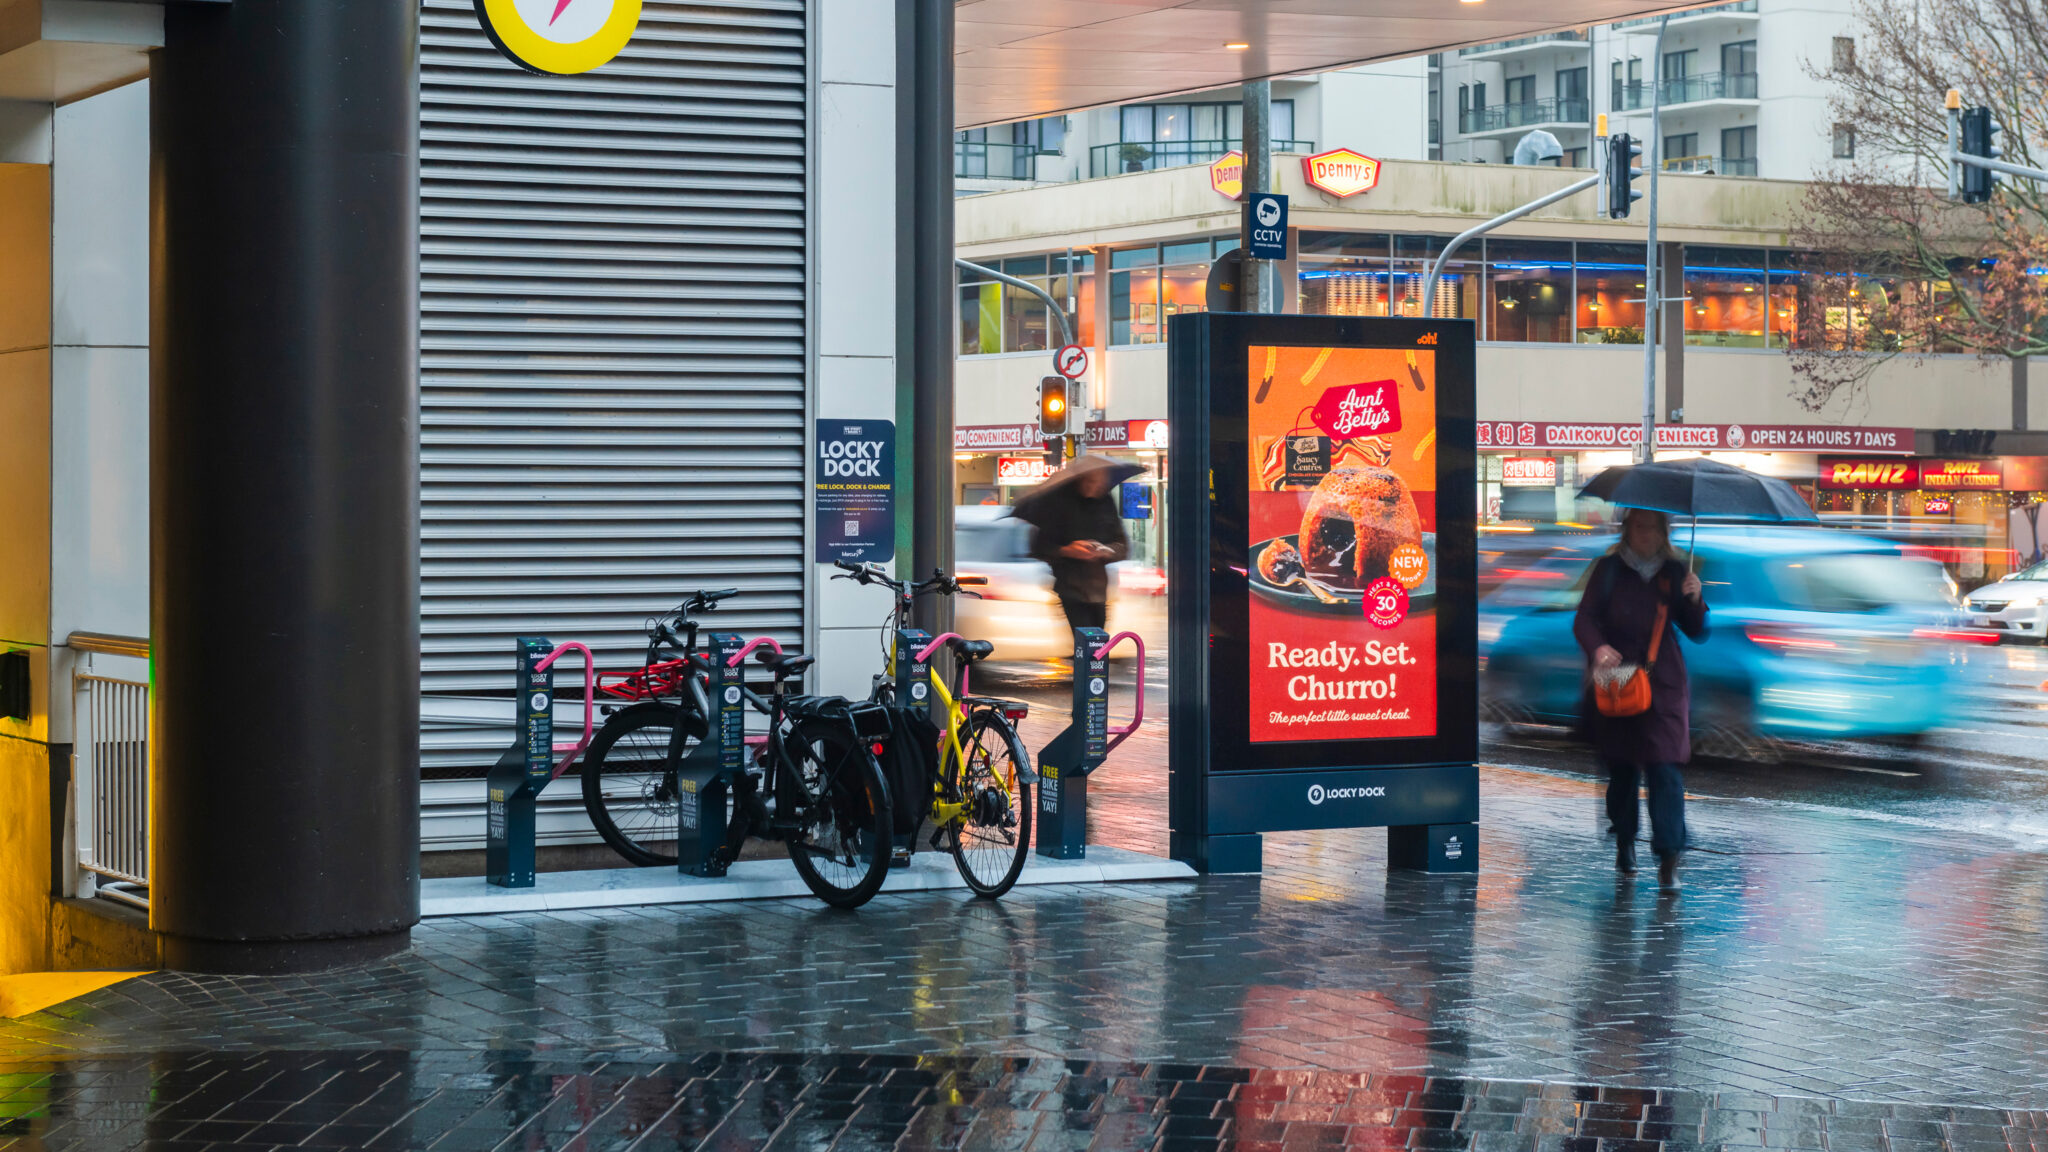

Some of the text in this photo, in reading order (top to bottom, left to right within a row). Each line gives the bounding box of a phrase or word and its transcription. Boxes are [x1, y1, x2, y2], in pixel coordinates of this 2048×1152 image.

[1216, 165, 1242, 184] Denny
[1316, 161, 1371, 181] Denny's
[1254, 229, 1282, 242] CCTV
[1339, 387, 1383, 413] Aunt
[1333, 408, 1390, 434] Betty's
[968, 429, 1020, 445] CONVENIENCE
[1097, 427, 1103, 441] 7
[1104, 427, 1126, 441] DAYS
[1546, 425, 1718, 445] DAIKOKU COENIENCE
[1751, 430, 1896, 447] OPEN 24 HOURS 7 DAYS
[820, 441, 884, 458] LOCKY
[1293, 463, 1322, 471] Centres
[1296, 455, 1319, 465] Saucy
[824, 459, 880, 477] DOCK
[1832, 463, 1908, 484] RAVIZ
[1943, 462, 1980, 473] RAVIZ
[1925, 474, 1999, 486] INDIAN CUISINE
[1926, 502, 1948, 511] OPEN
[1394, 556, 1423, 568] NEW
[1368, 582, 1383, 597] HEAT
[1392, 584, 1403, 597] EAT
[1375, 596, 1397, 610] 30
[1369, 613, 1402, 625] SECONDS
[1267, 640, 1416, 672] Ready. Set.
[1287, 673, 1396, 701] Churro!
[1269, 708, 1411, 726] The perfect little sweet cheat.
[1043, 765, 1058, 779] FREE
[682, 779, 696, 792] FREE
[1042, 777, 1058, 791] BIKE
[490, 788, 504, 801] FREE
[682, 792, 696, 805] BIKE
[1327, 786, 1386, 799] LOCKY DOCK
[490, 802, 504, 814] BIKE
[1042, 800, 1057, 813] YAY!
[682, 816, 696, 829] YAY!
[490, 826, 504, 839] YAY!
